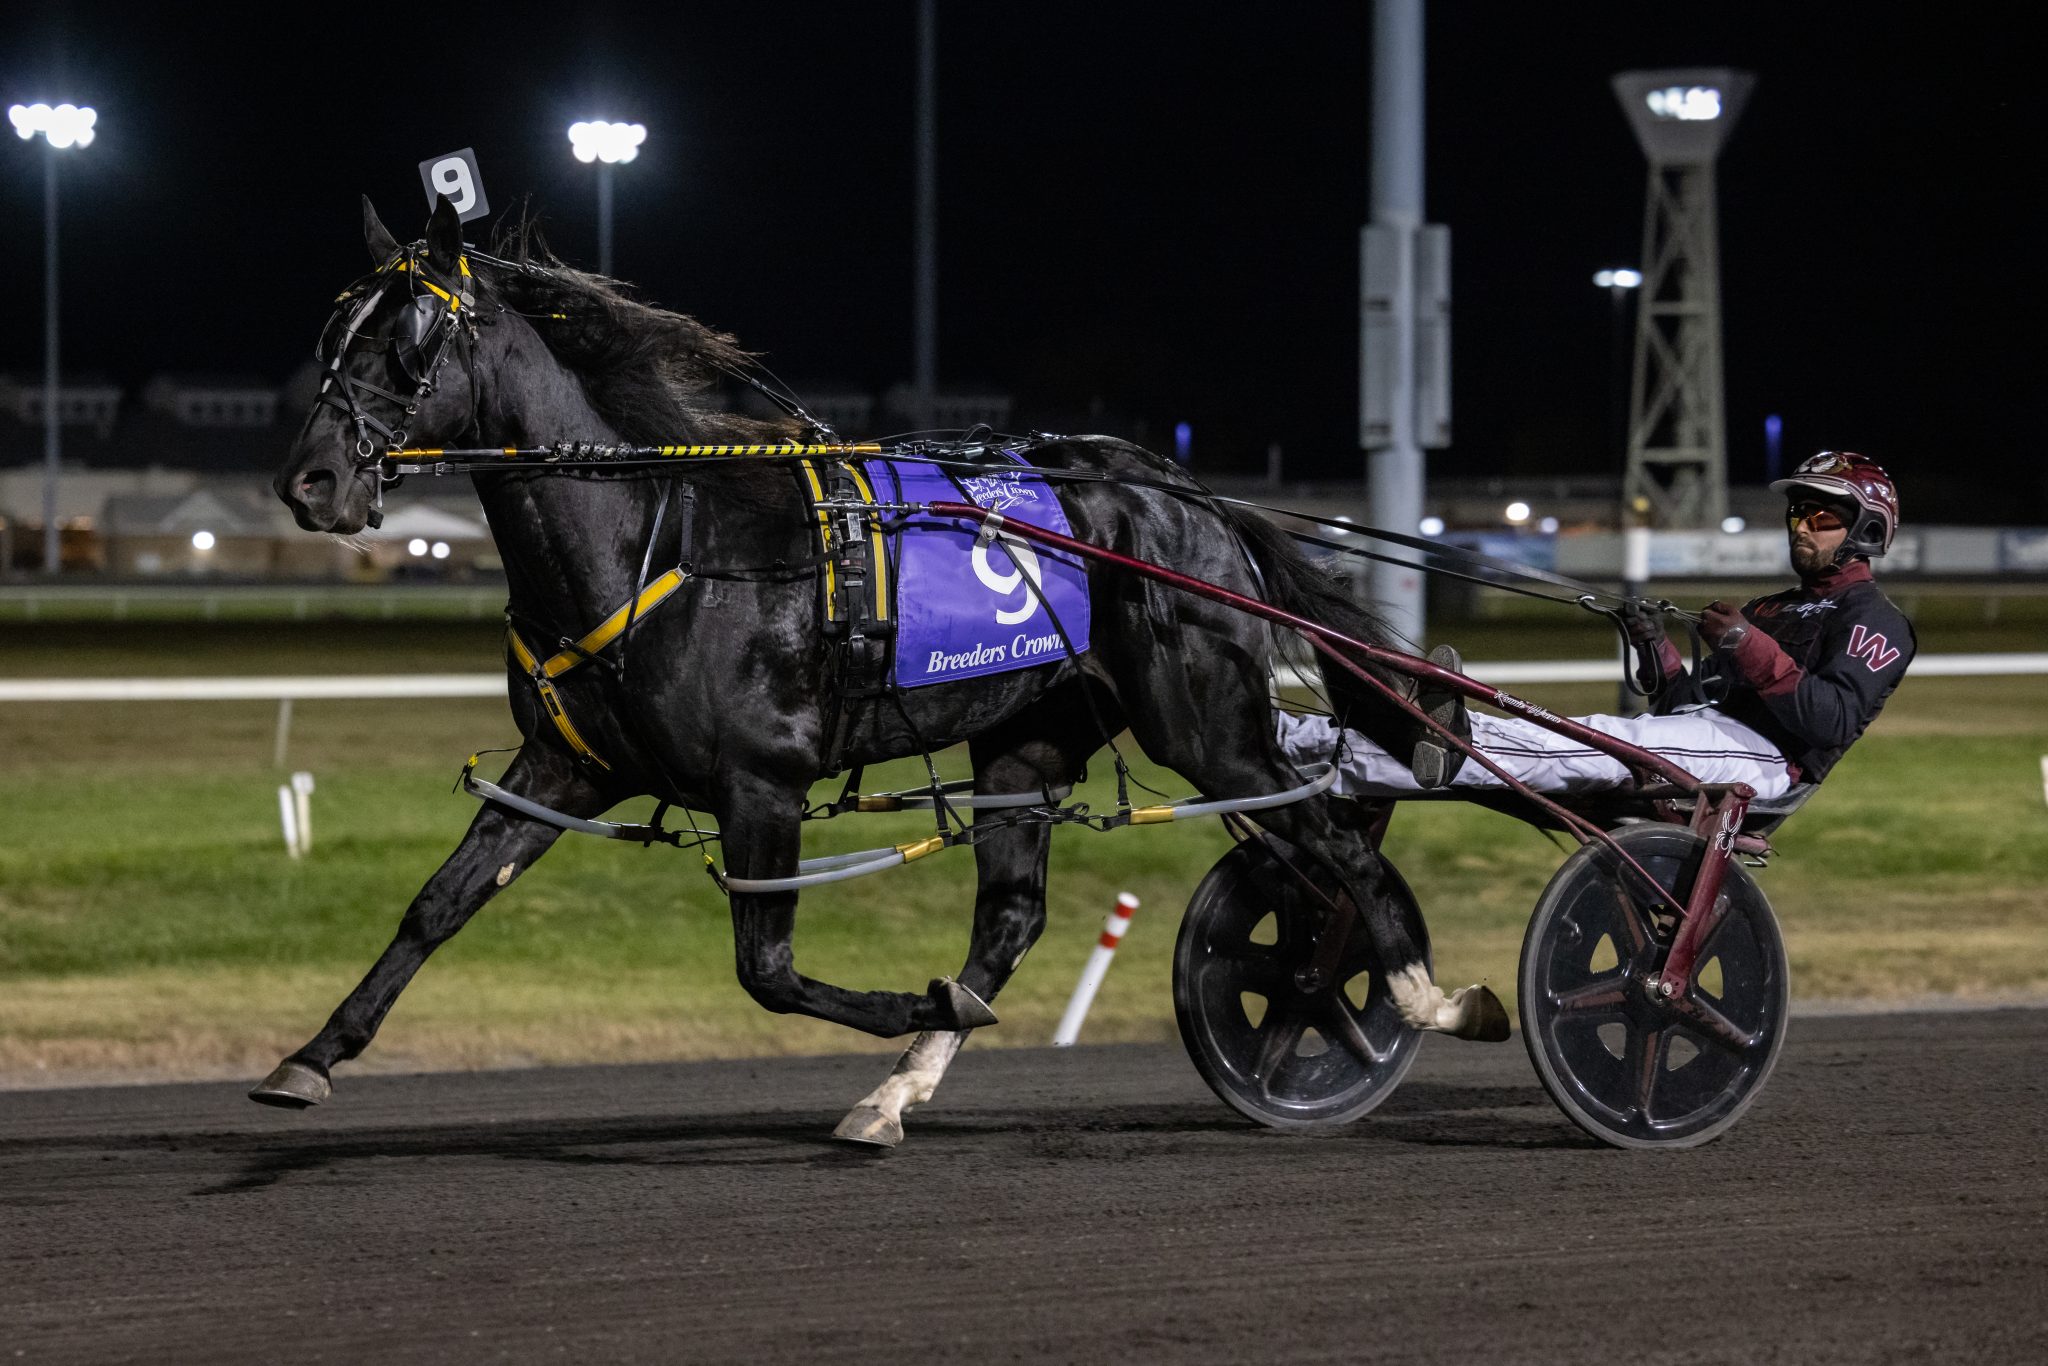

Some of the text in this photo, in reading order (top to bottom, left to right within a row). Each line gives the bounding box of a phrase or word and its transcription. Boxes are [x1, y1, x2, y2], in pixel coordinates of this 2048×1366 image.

[431, 157, 476, 215] 9
[1003, 482, 1038, 501] Crown
[972, 529, 1042, 625] 9
[926, 642, 1006, 673] Breeders
[1847, 624, 1900, 672] W
